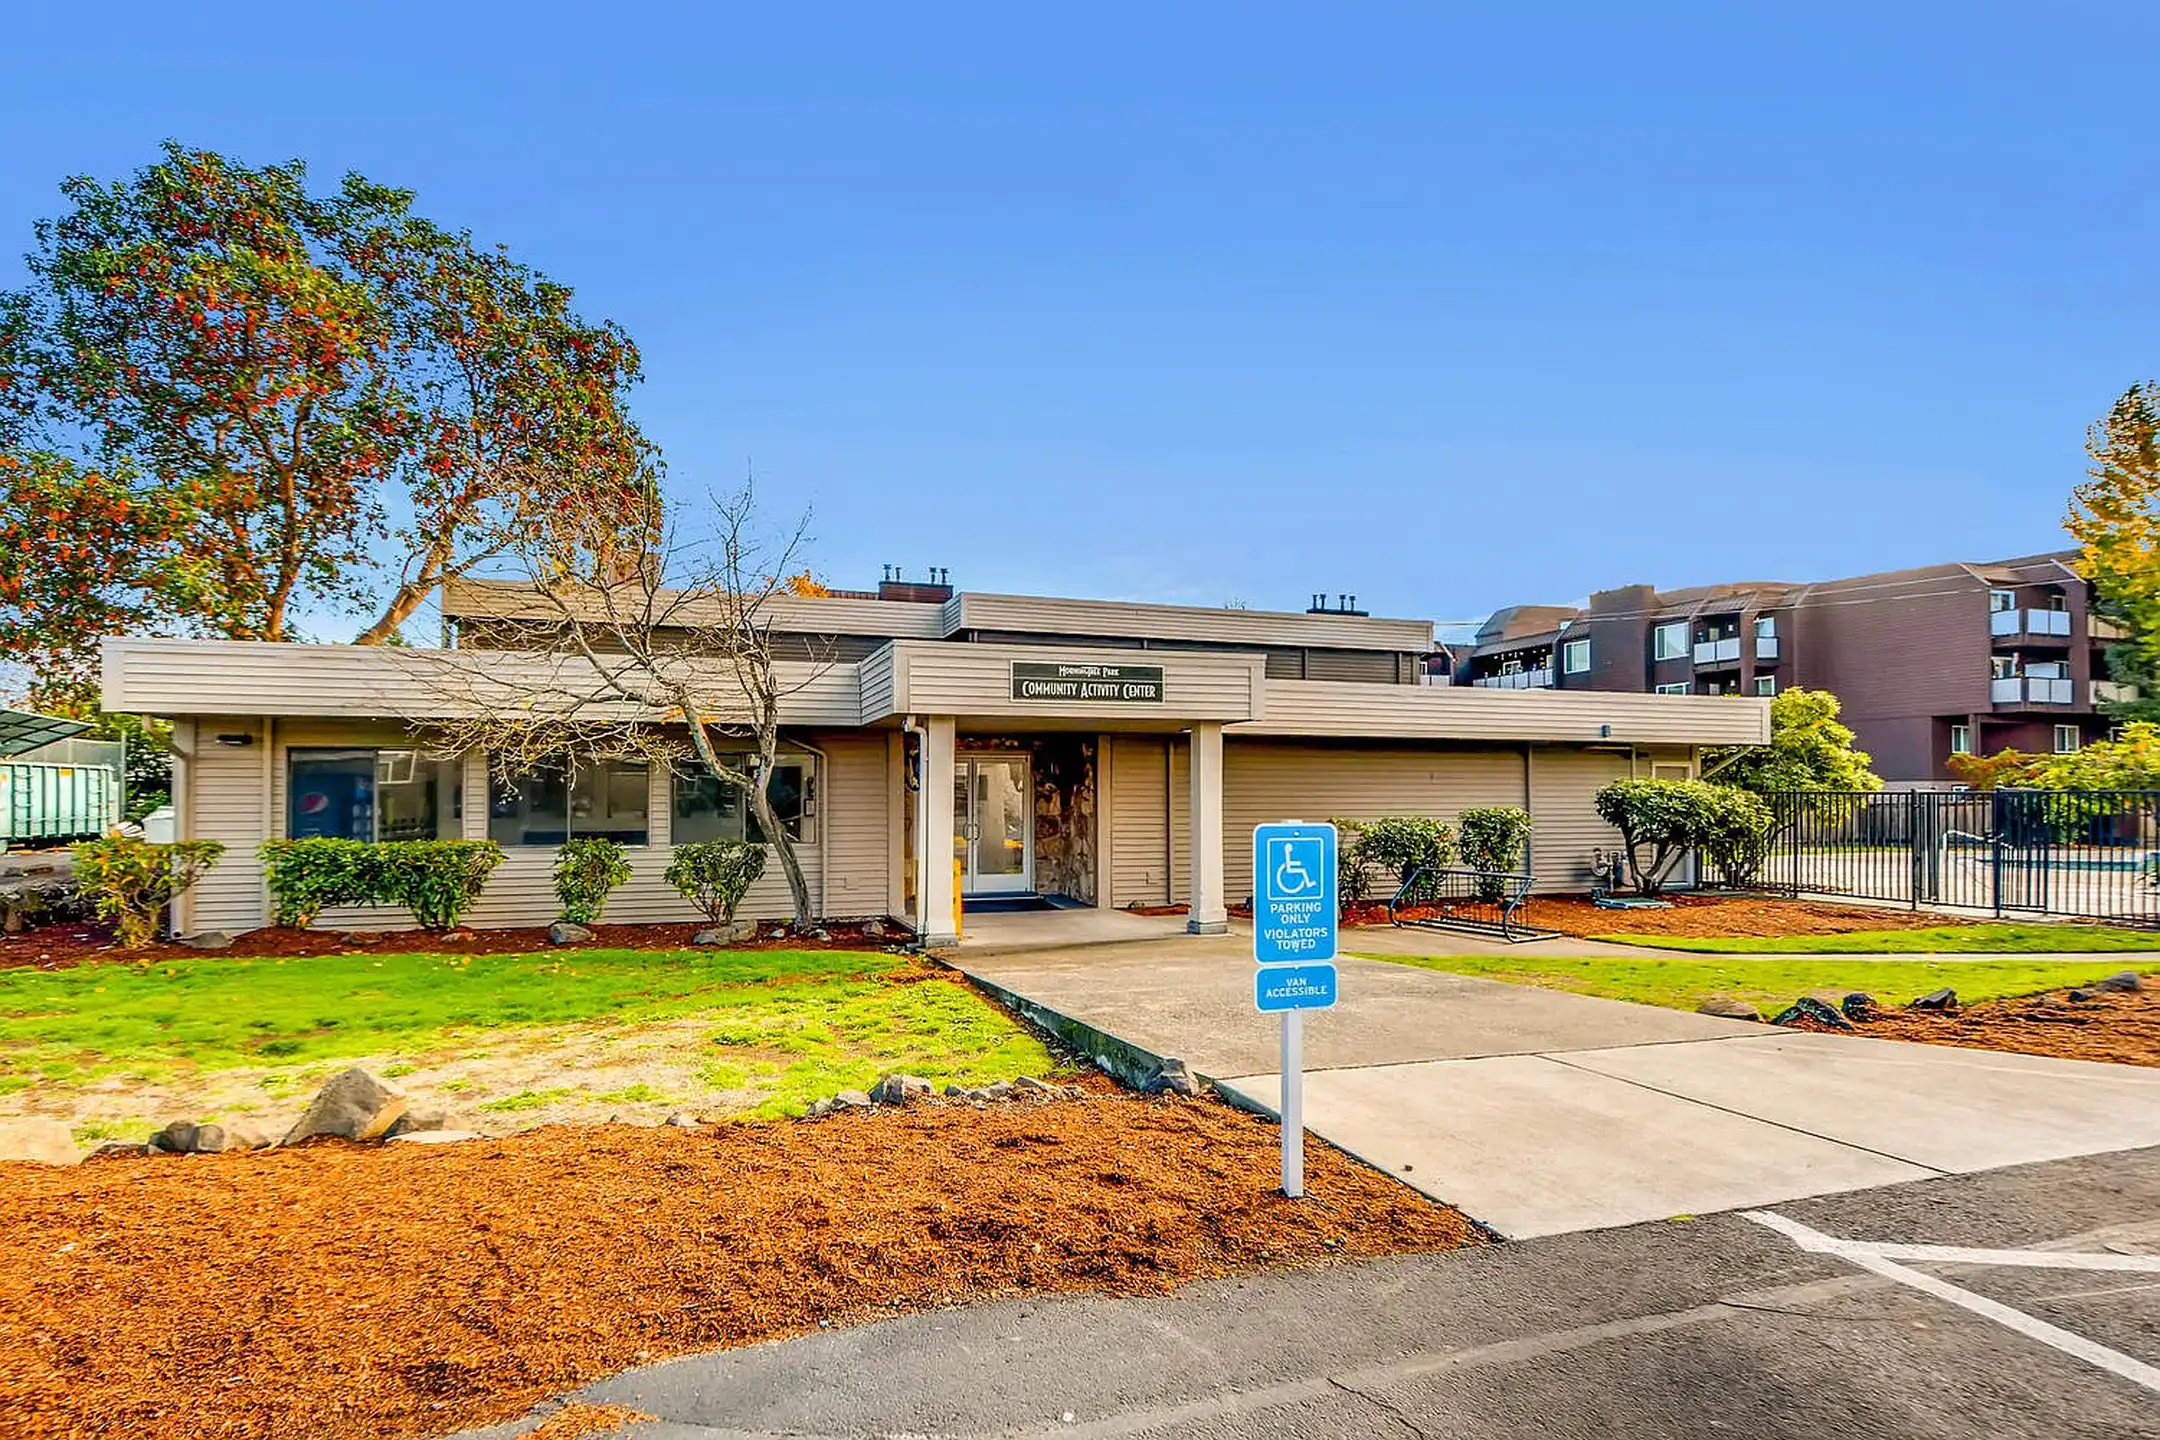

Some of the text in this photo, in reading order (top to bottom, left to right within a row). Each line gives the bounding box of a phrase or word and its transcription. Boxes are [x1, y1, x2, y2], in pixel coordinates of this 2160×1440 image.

[1022, 681, 1156, 699] COMMUNITY ACTIVITY CENTER
[1270, 903, 1321, 914] PARKING
[1280, 913, 1311, 924] ONLY
[1264, 928, 1327, 940] VIOLATORS
[1276, 938, 1316, 950] TOWED
[1286, 978, 1307, 987] VAN
[1266, 986, 1327, 998] ACCESSIBLE
